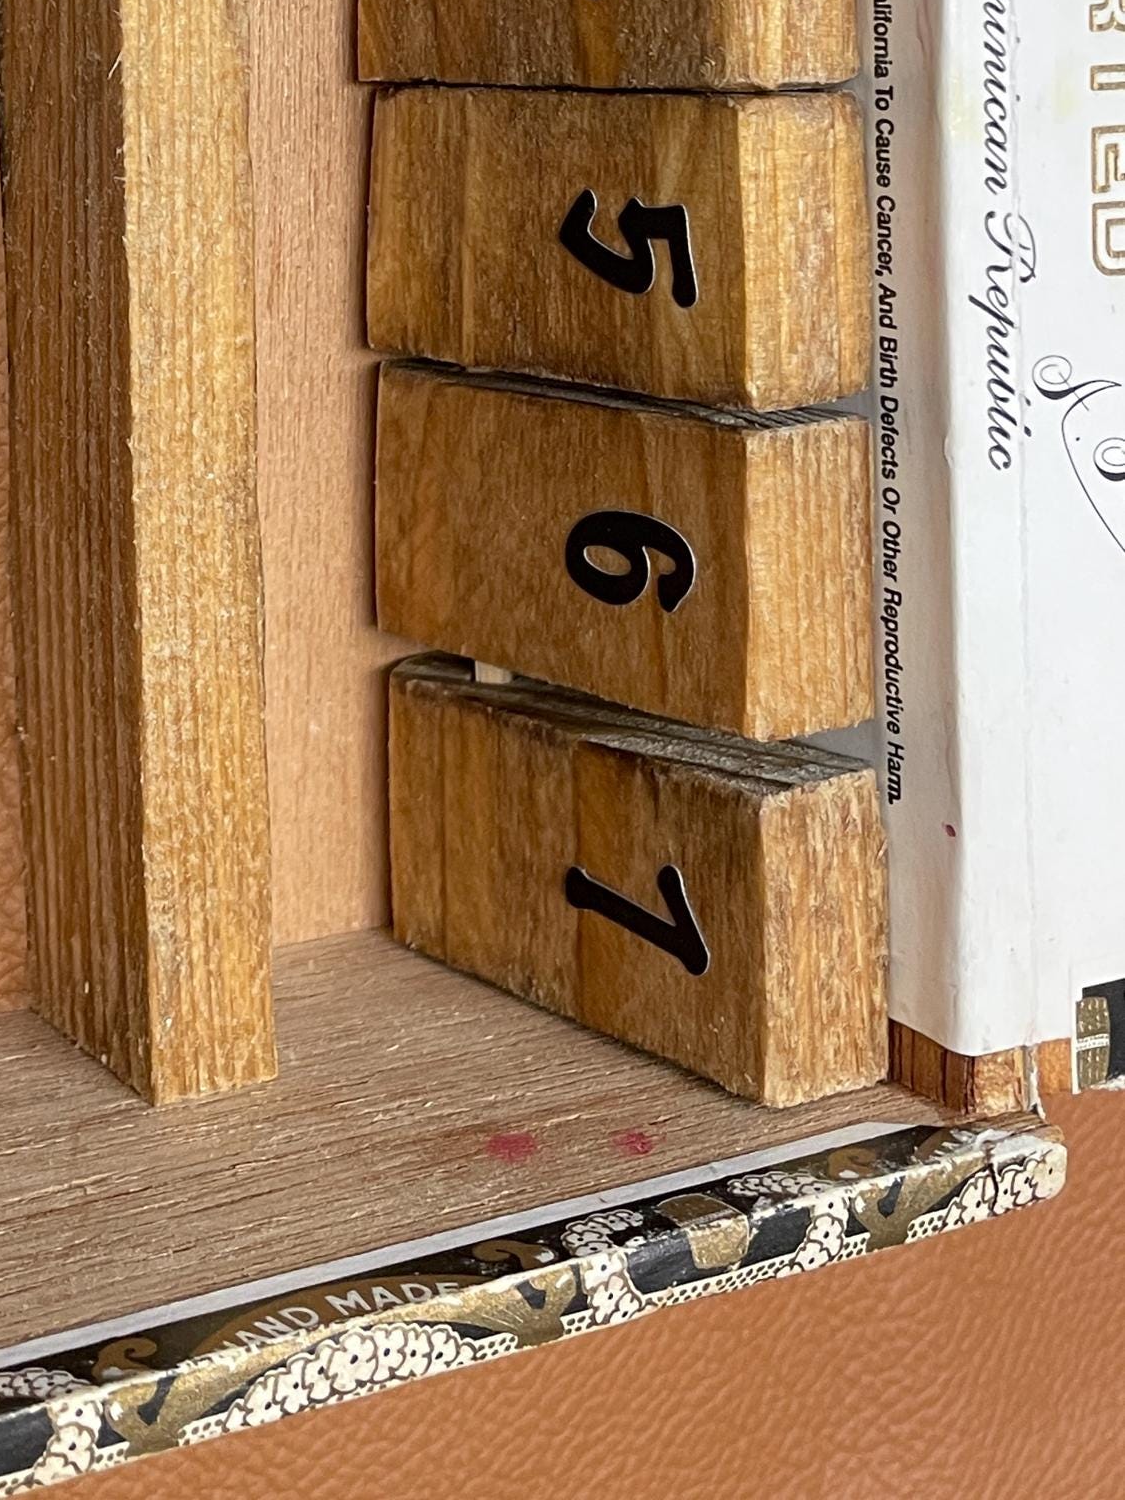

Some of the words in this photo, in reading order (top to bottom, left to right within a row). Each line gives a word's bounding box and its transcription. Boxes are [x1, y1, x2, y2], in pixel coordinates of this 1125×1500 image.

[875, 86, 893, 111] To
[875, 118, 894, 187] Cause
[559, 187, 698, 308] 5
[874, 195, 895, 277] Cancer,
[878, 284, 897, 328] And
[968, 211, 1036, 471] Republic
[879, 337, 898, 388] Birth
[881, 396, 899, 481] Defects
[882, 488, 900, 514] Or
[566, 510, 696, 612] 6
[882, 521, 901, 581] Other
[882, 589, 903, 733] Reproductive
[886, 742, 905, 804] Harm.
[564, 864, 709, 976] 7
